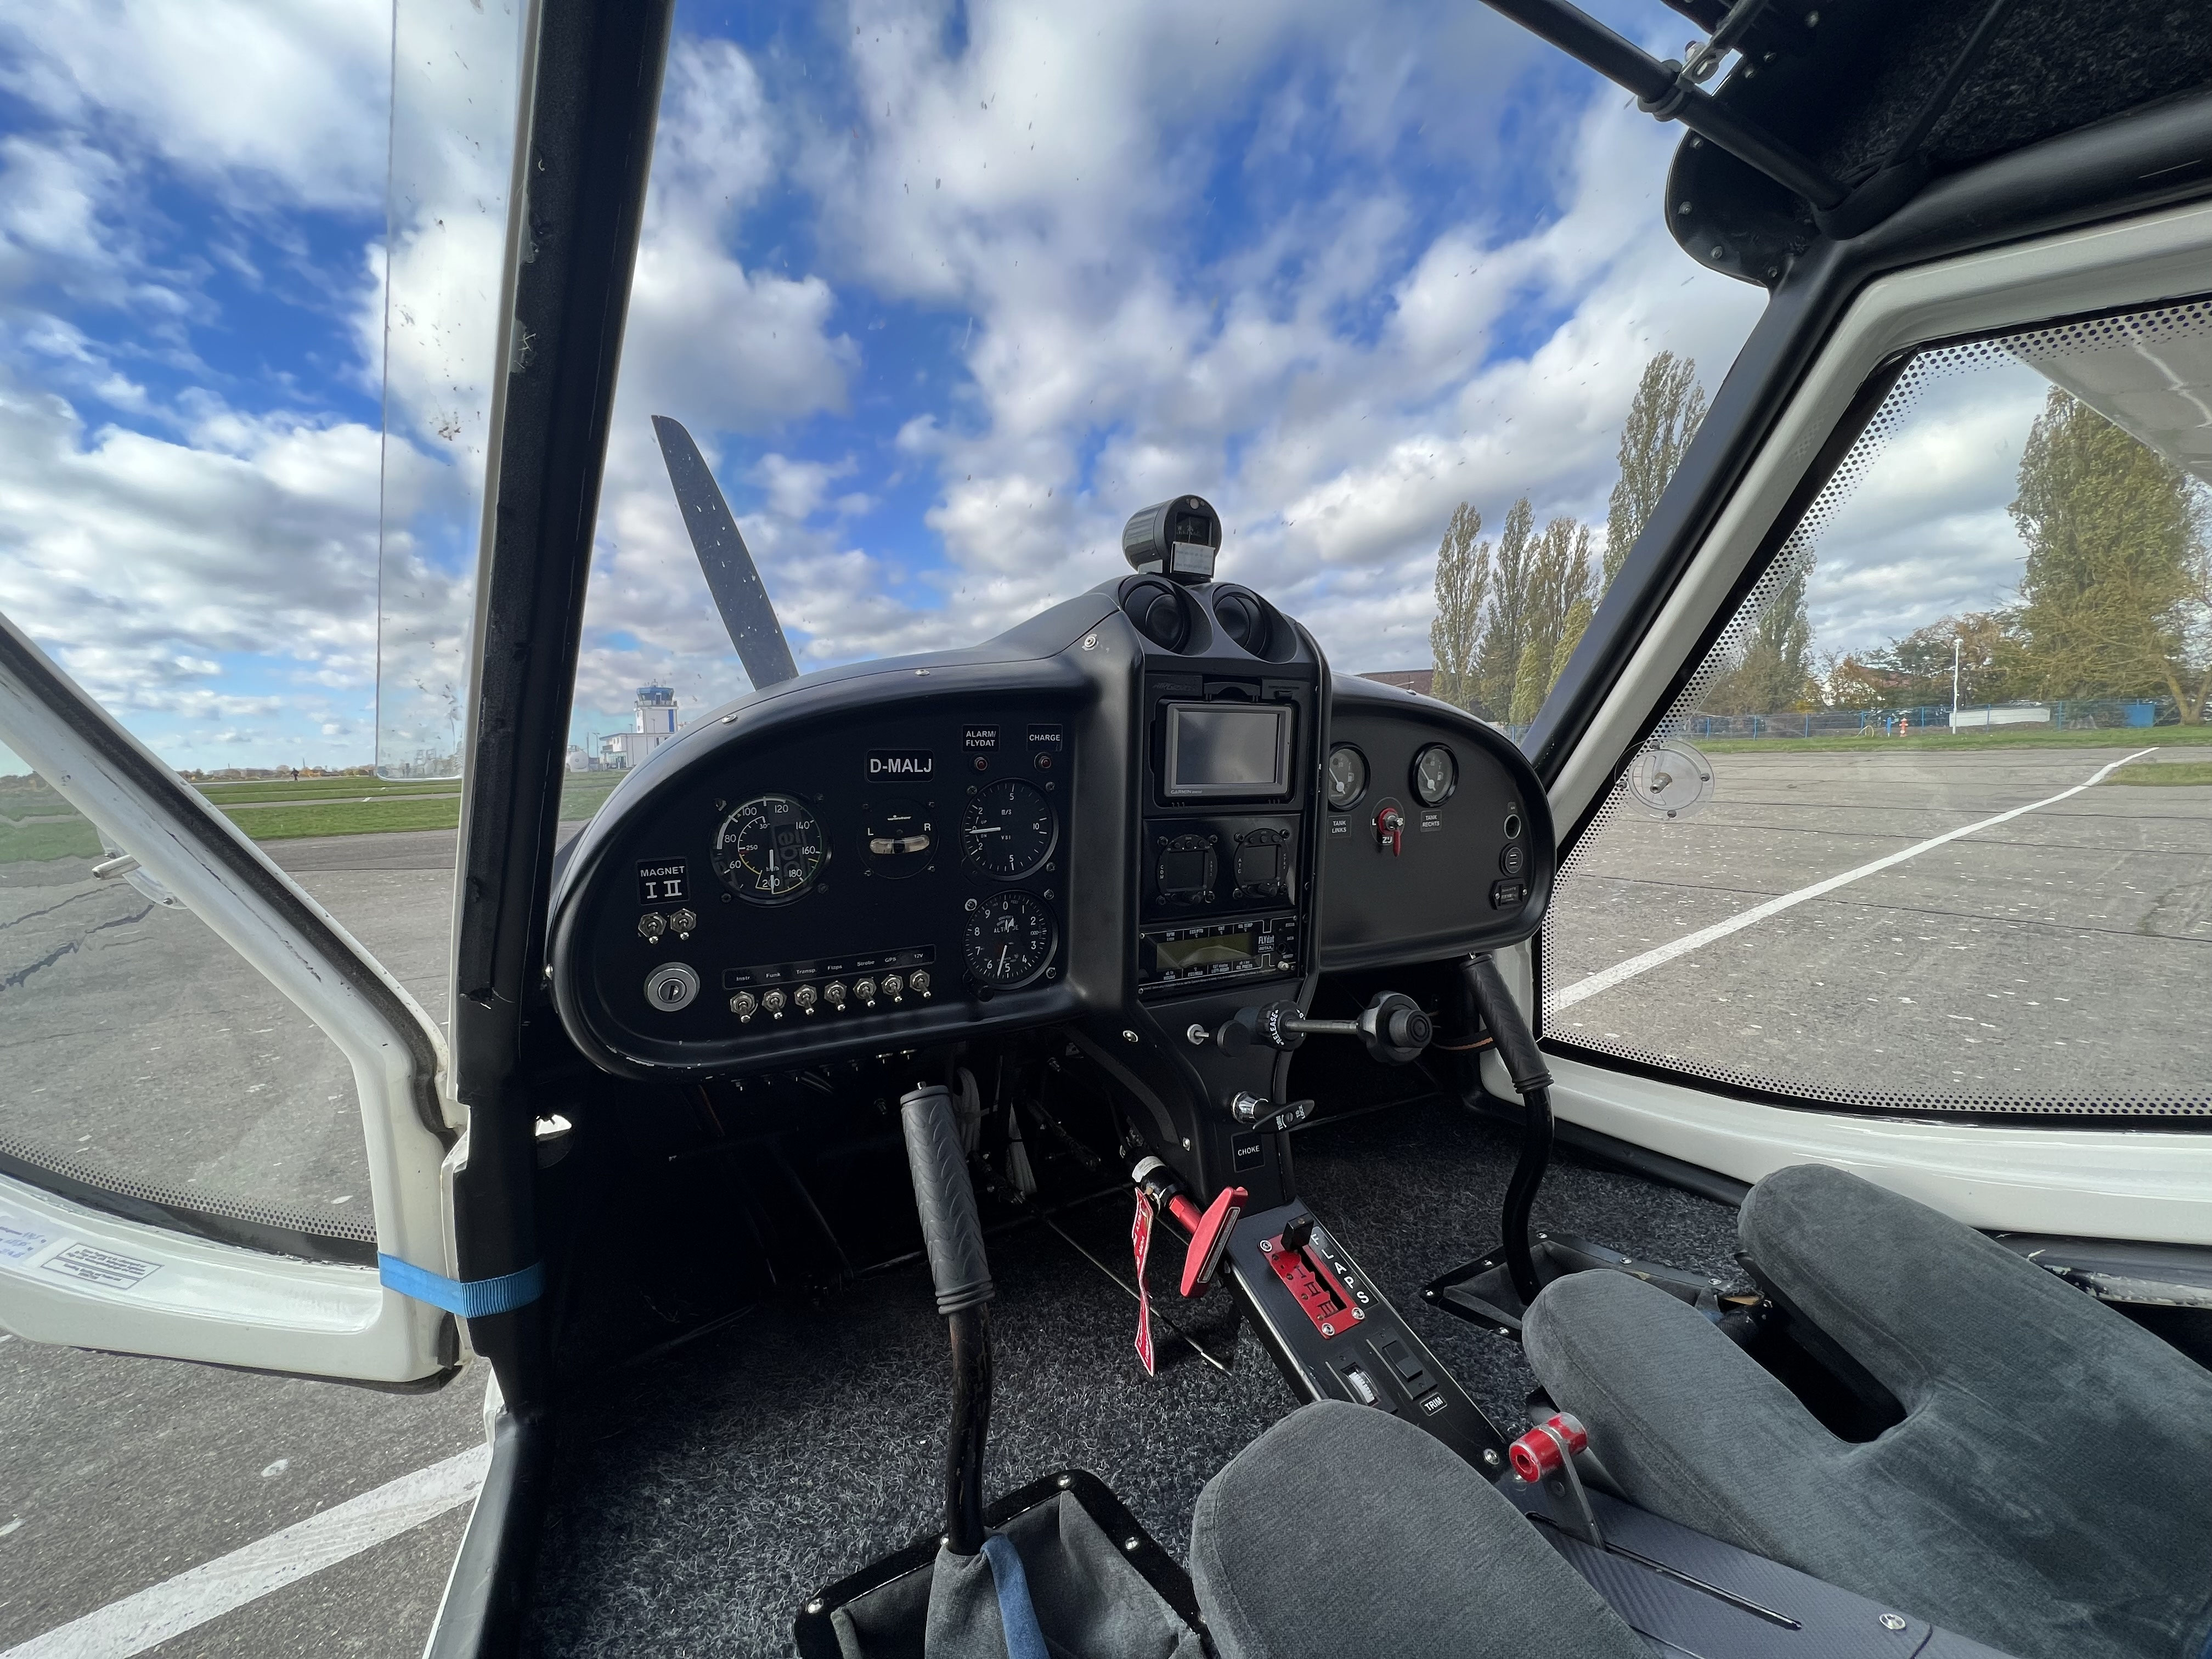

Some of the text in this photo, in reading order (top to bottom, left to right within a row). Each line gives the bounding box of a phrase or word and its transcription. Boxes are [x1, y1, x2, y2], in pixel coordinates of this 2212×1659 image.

[870, 758, 932, 773] D-MALJ
[742, 807, 757, 816] 100
[774, 804, 789, 813] 120
[795, 821, 810, 830] 140
[924, 823, 931, 831] R
[867, 827, 874, 836] L
[724, 834, 736, 843] 80
[802, 846, 816, 854] 160
[1009, 854, 1014, 862] 5
[729, 860, 741, 868] 60
[640, 866, 685, 877] MAGNET
[789, 868, 803, 877] 180
[1002, 901, 1008, 910] 0
[985, 909, 991, 919] 9
[1030, 916, 1036, 926] 2
[974, 927, 980, 936] 8
[1031, 940, 1036, 950] 3
[975, 946, 981, 956] 7
[1022, 955, 1028, 963] 4
[987, 960, 993, 969] 6
[1005, 963, 1011, 973] 5
[1269, 1012, 1282, 1045] RELEASE
[1238, 1145, 1260, 1156] CHOKE
[1310, 1233, 1369, 1304] FLAPS
[1424, 1396, 1444, 1412] TRIM
